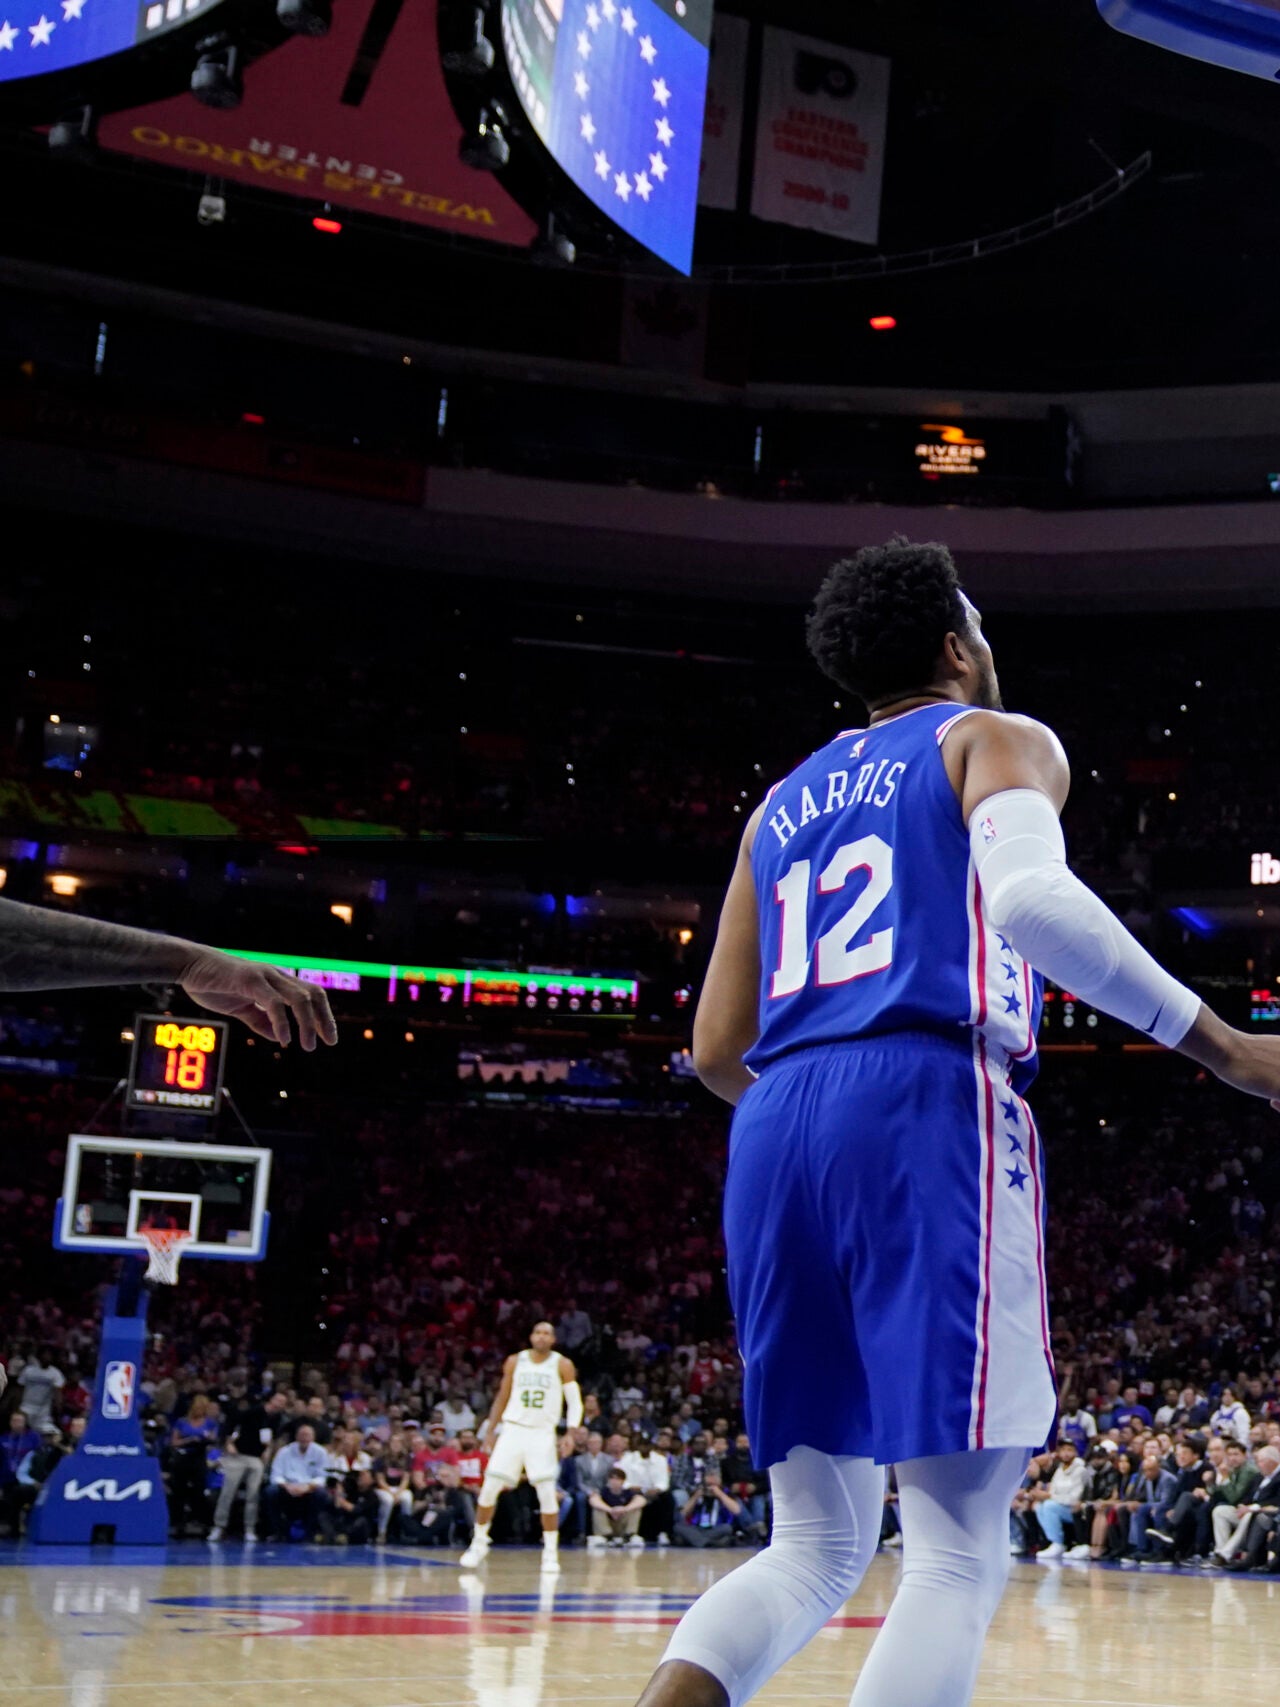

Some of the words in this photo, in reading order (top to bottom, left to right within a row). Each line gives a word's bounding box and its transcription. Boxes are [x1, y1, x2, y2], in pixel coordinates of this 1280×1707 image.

[131, 126, 307, 183] FARGO
[772, 120, 868, 156] CONFERENCE
[773, 136, 864, 172] CHAMPIONS
[249, 138, 403, 185] CENTER
[323, 170, 496, 226] WELLS
[915, 444, 986, 459] RIVERS
[768, 758, 906, 848] HARRIS
[767, 833, 894, 1000] 12
[164, 1049, 206, 1090] 18
[157, 1090, 215, 1108] TISSOT
[520, 1389, 545, 1408] 42
[64, 1478, 153, 1501] KIA
